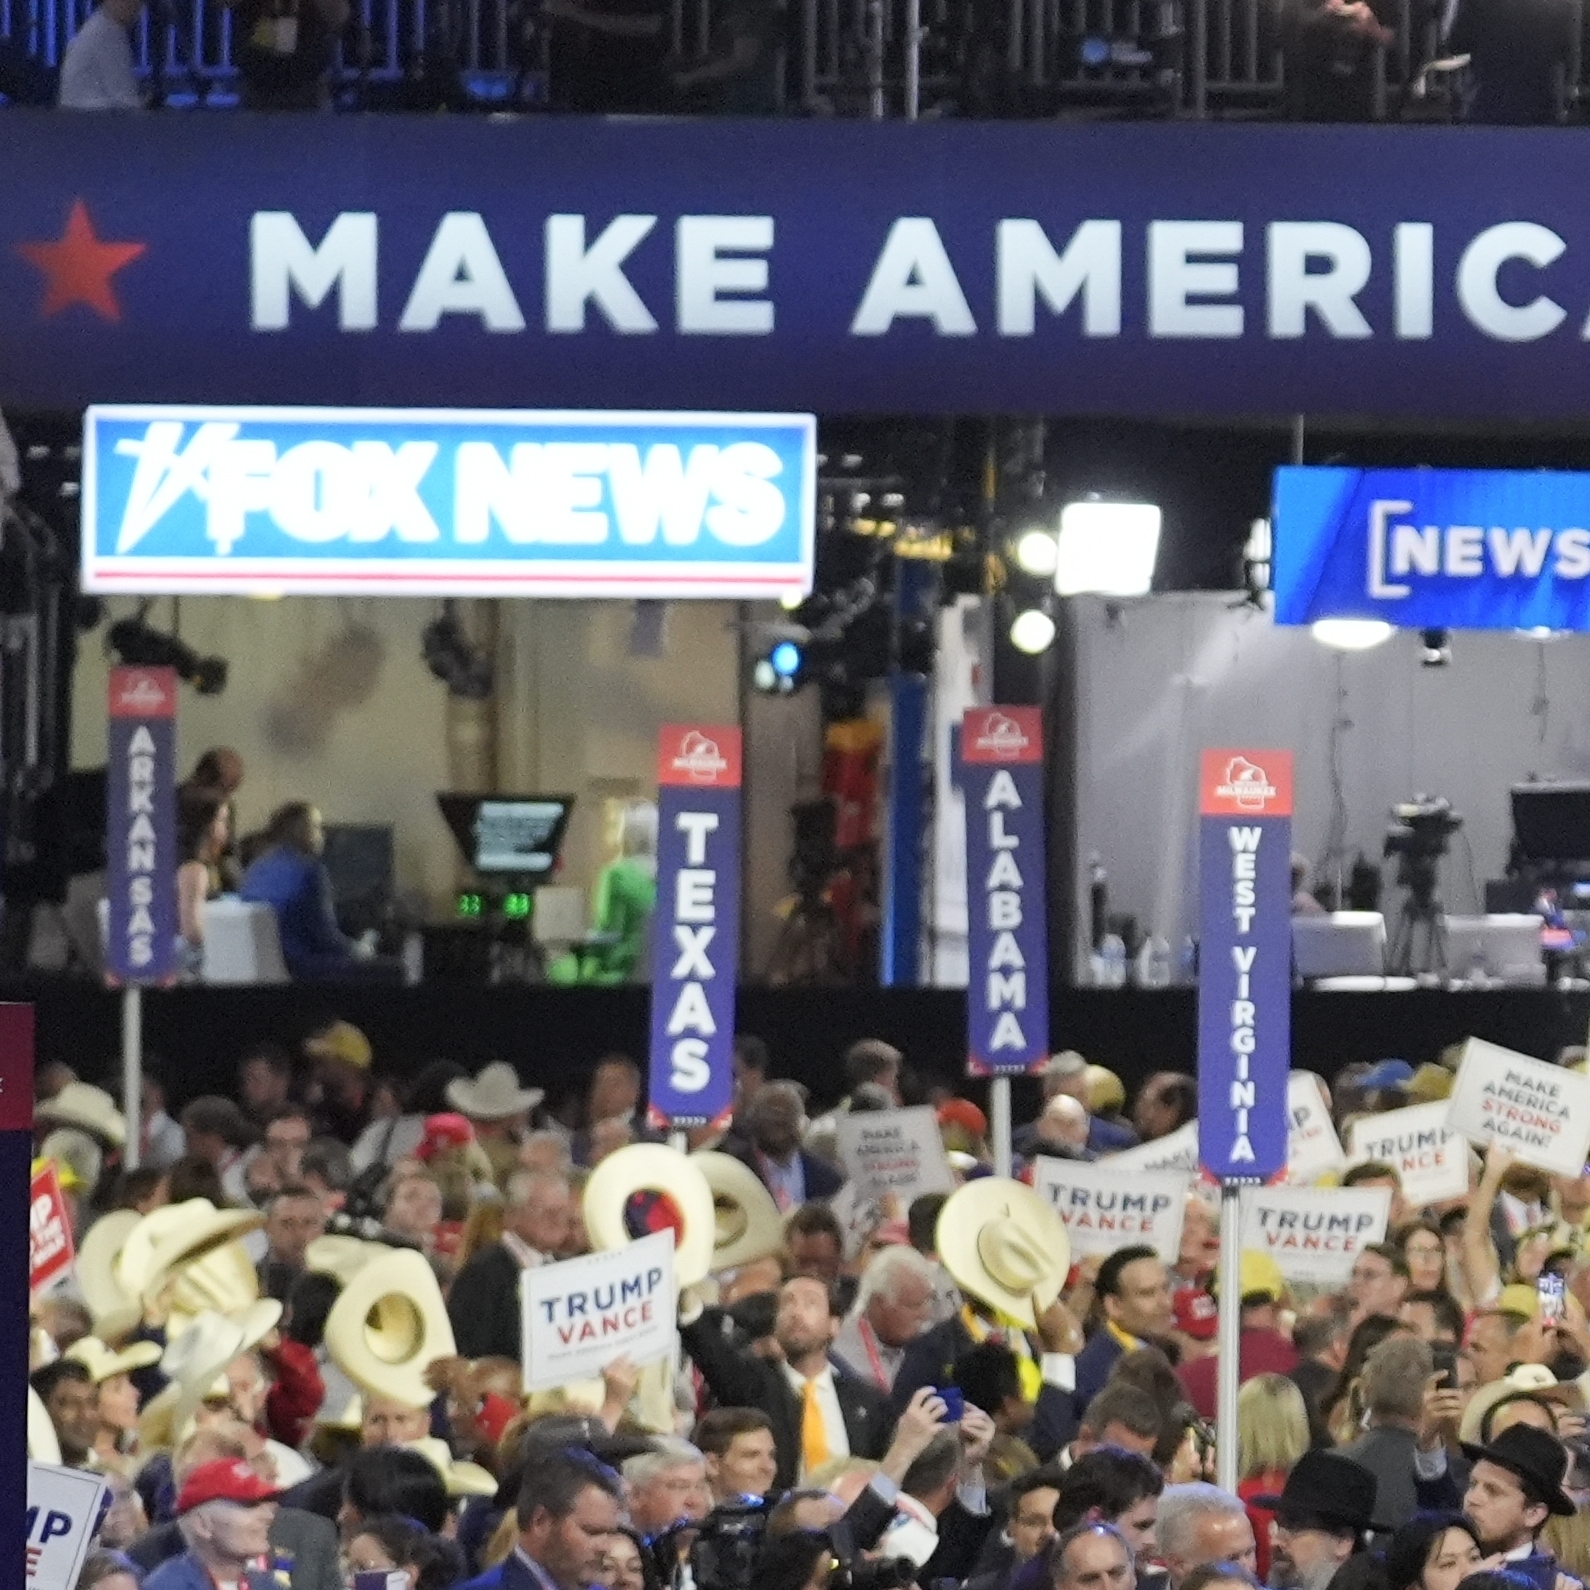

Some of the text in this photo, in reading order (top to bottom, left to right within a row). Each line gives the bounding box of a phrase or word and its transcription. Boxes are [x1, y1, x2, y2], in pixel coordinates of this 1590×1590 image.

[249, 211, 776, 335] MAKE
[206, 438, 787, 547] FOX NEWS
[127, 724, 157, 966] ARKANSAS
[982, 768, 1028, 1052] ALABAMA
[667, 811, 721, 1093] TEXAS
[1228, 825, 1263, 1164] WEST VIRGINIA
[1505, 1069, 1562, 1096] MAKE
[1482, 1100, 1562, 1134] STRONG
[1484, 1083, 1571, 1120] AMERICA
[1483, 1119, 1550, 1149] AGAIN!
[1402, 1153, 1444, 1172] NCE
[1049, 1182, 1172, 1213] TRUMP
[1062, 1210, 1154, 1233] VANCE
[1257, 1208, 1374, 1233] TRUMP
[1267, 1233, 1359, 1251] VANCE
[539, 1267, 663, 1324] TRUMP
[557, 1301, 654, 1345] VANCE
